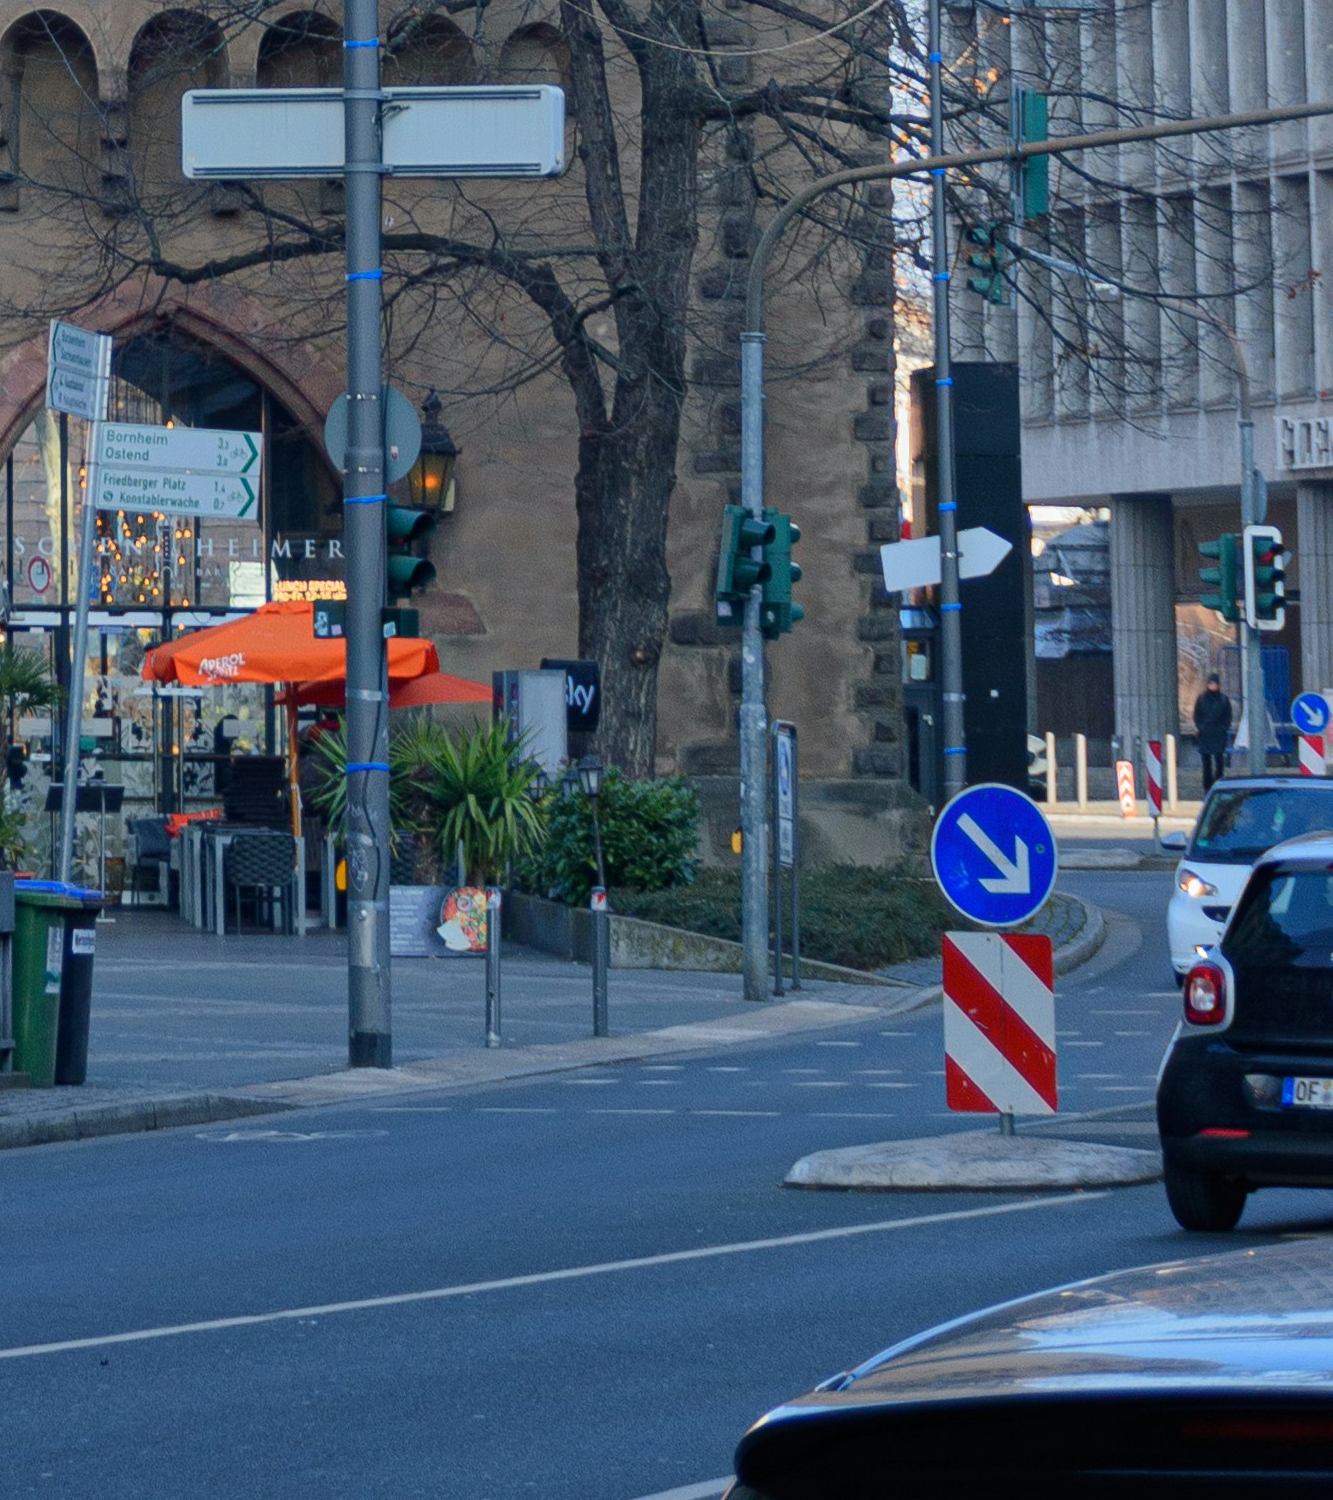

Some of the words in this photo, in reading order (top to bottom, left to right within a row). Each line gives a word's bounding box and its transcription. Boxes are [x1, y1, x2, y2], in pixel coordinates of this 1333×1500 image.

[106, 429, 168, 446] Bornheim
[105, 446, 150, 462] Ostend
[103, 472, 158, 490] Friedberger
[162, 477, 187, 491] Platz
[119, 491, 200, 510] Konstablerwache
[197, 651, 247, 676] APEROL
[1296, 1080, 1321, 1102] OF
